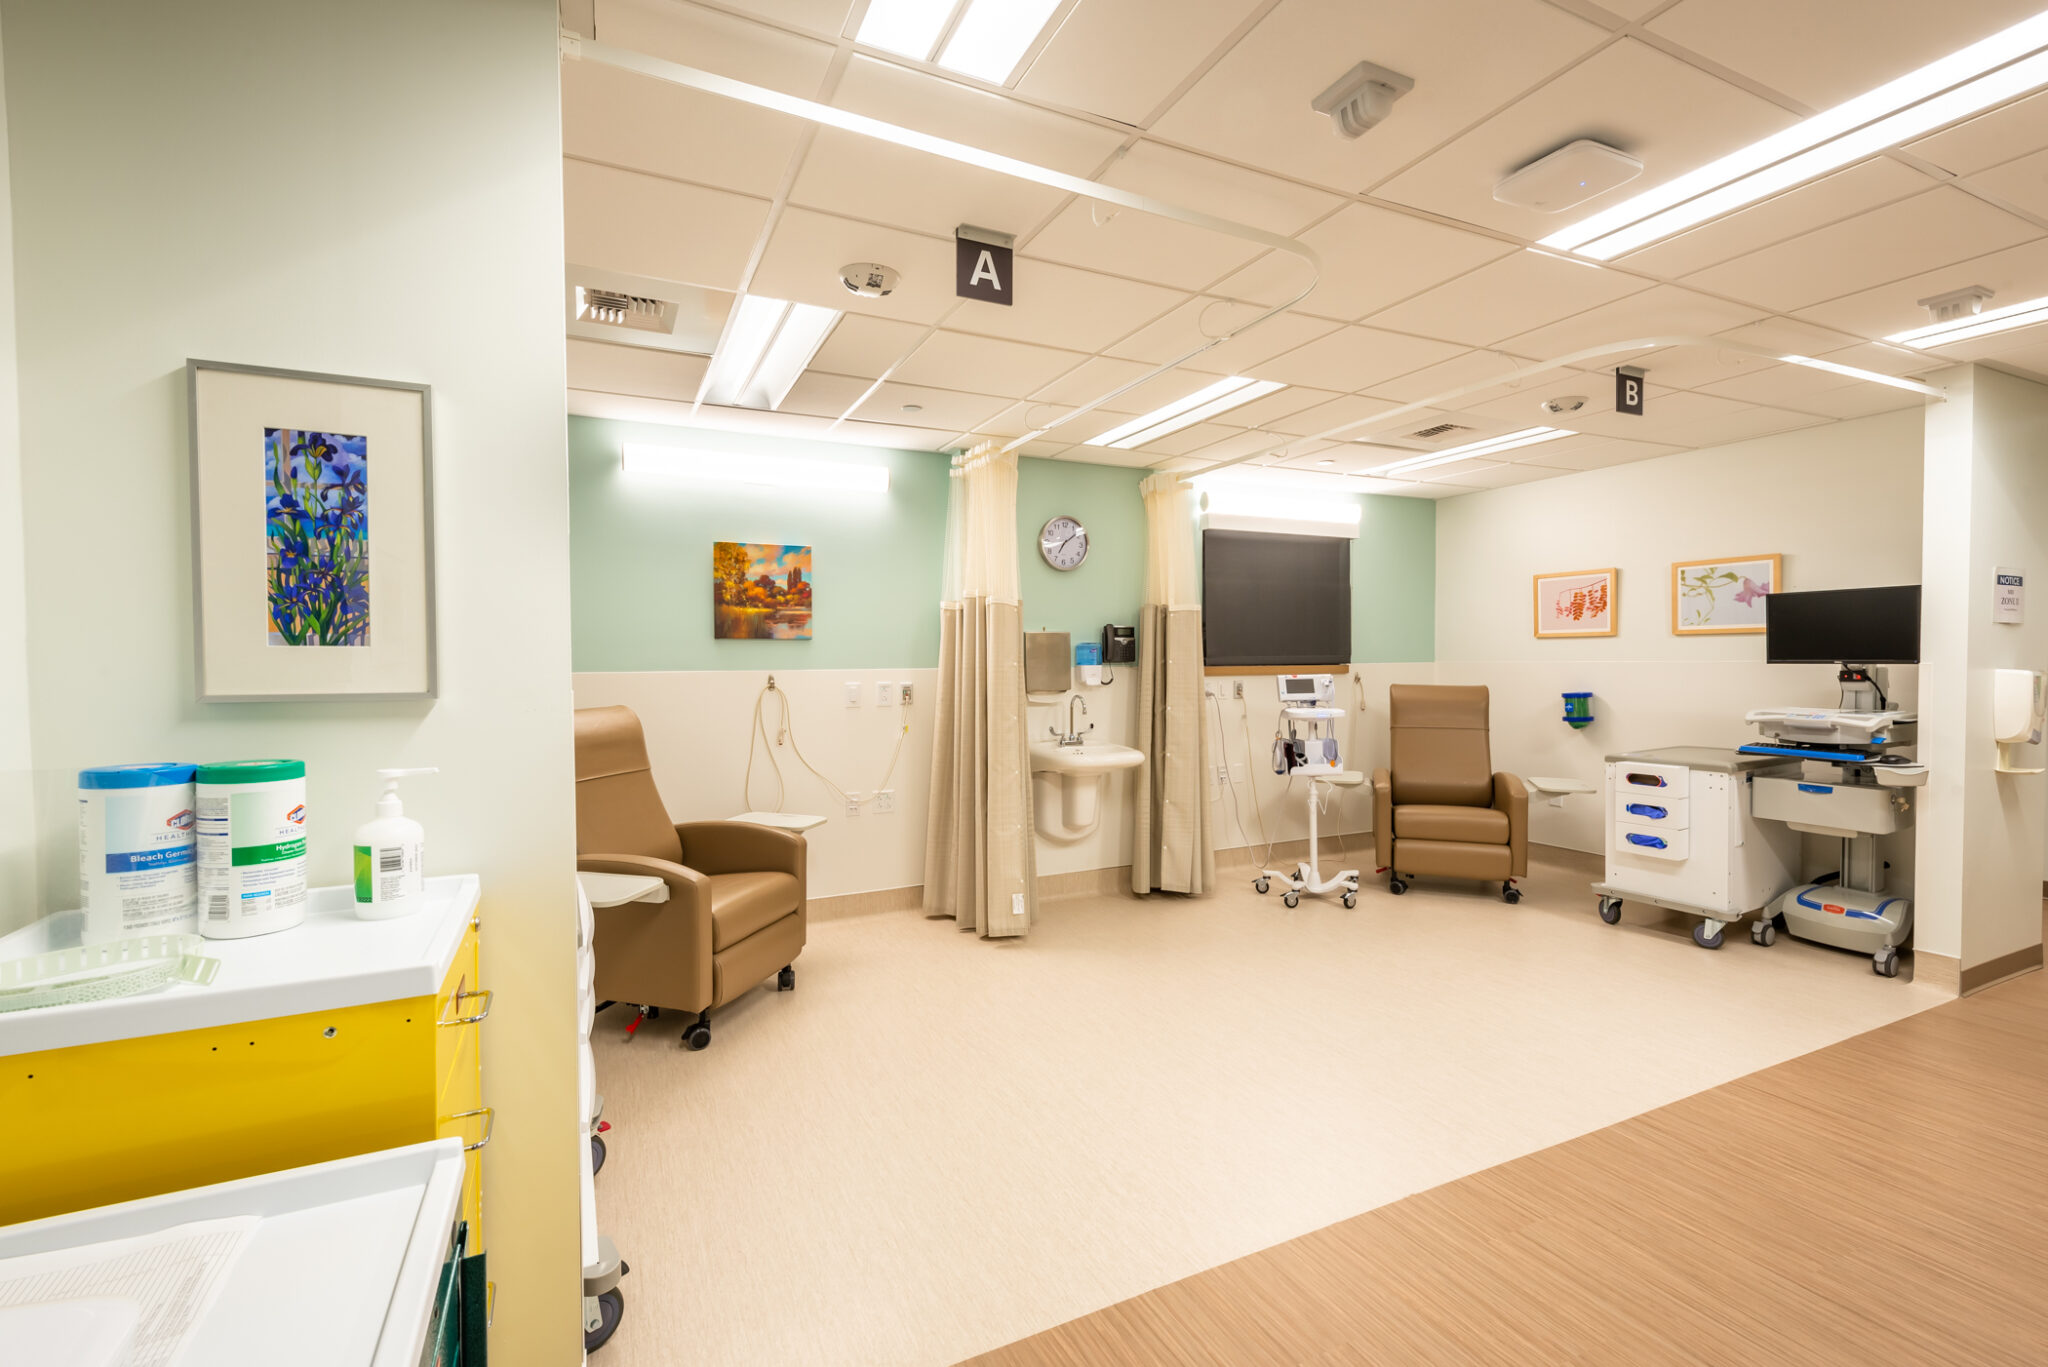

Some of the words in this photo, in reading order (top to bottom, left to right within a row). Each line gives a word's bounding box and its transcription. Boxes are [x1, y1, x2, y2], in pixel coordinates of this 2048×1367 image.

[969, 249, 1002, 291] A
[1625, 379, 1639, 406] B
[1999, 576, 2020, 586] NOTICE
[130, 852, 164, 863] Bleach
[165, 847, 193, 859] Germ
